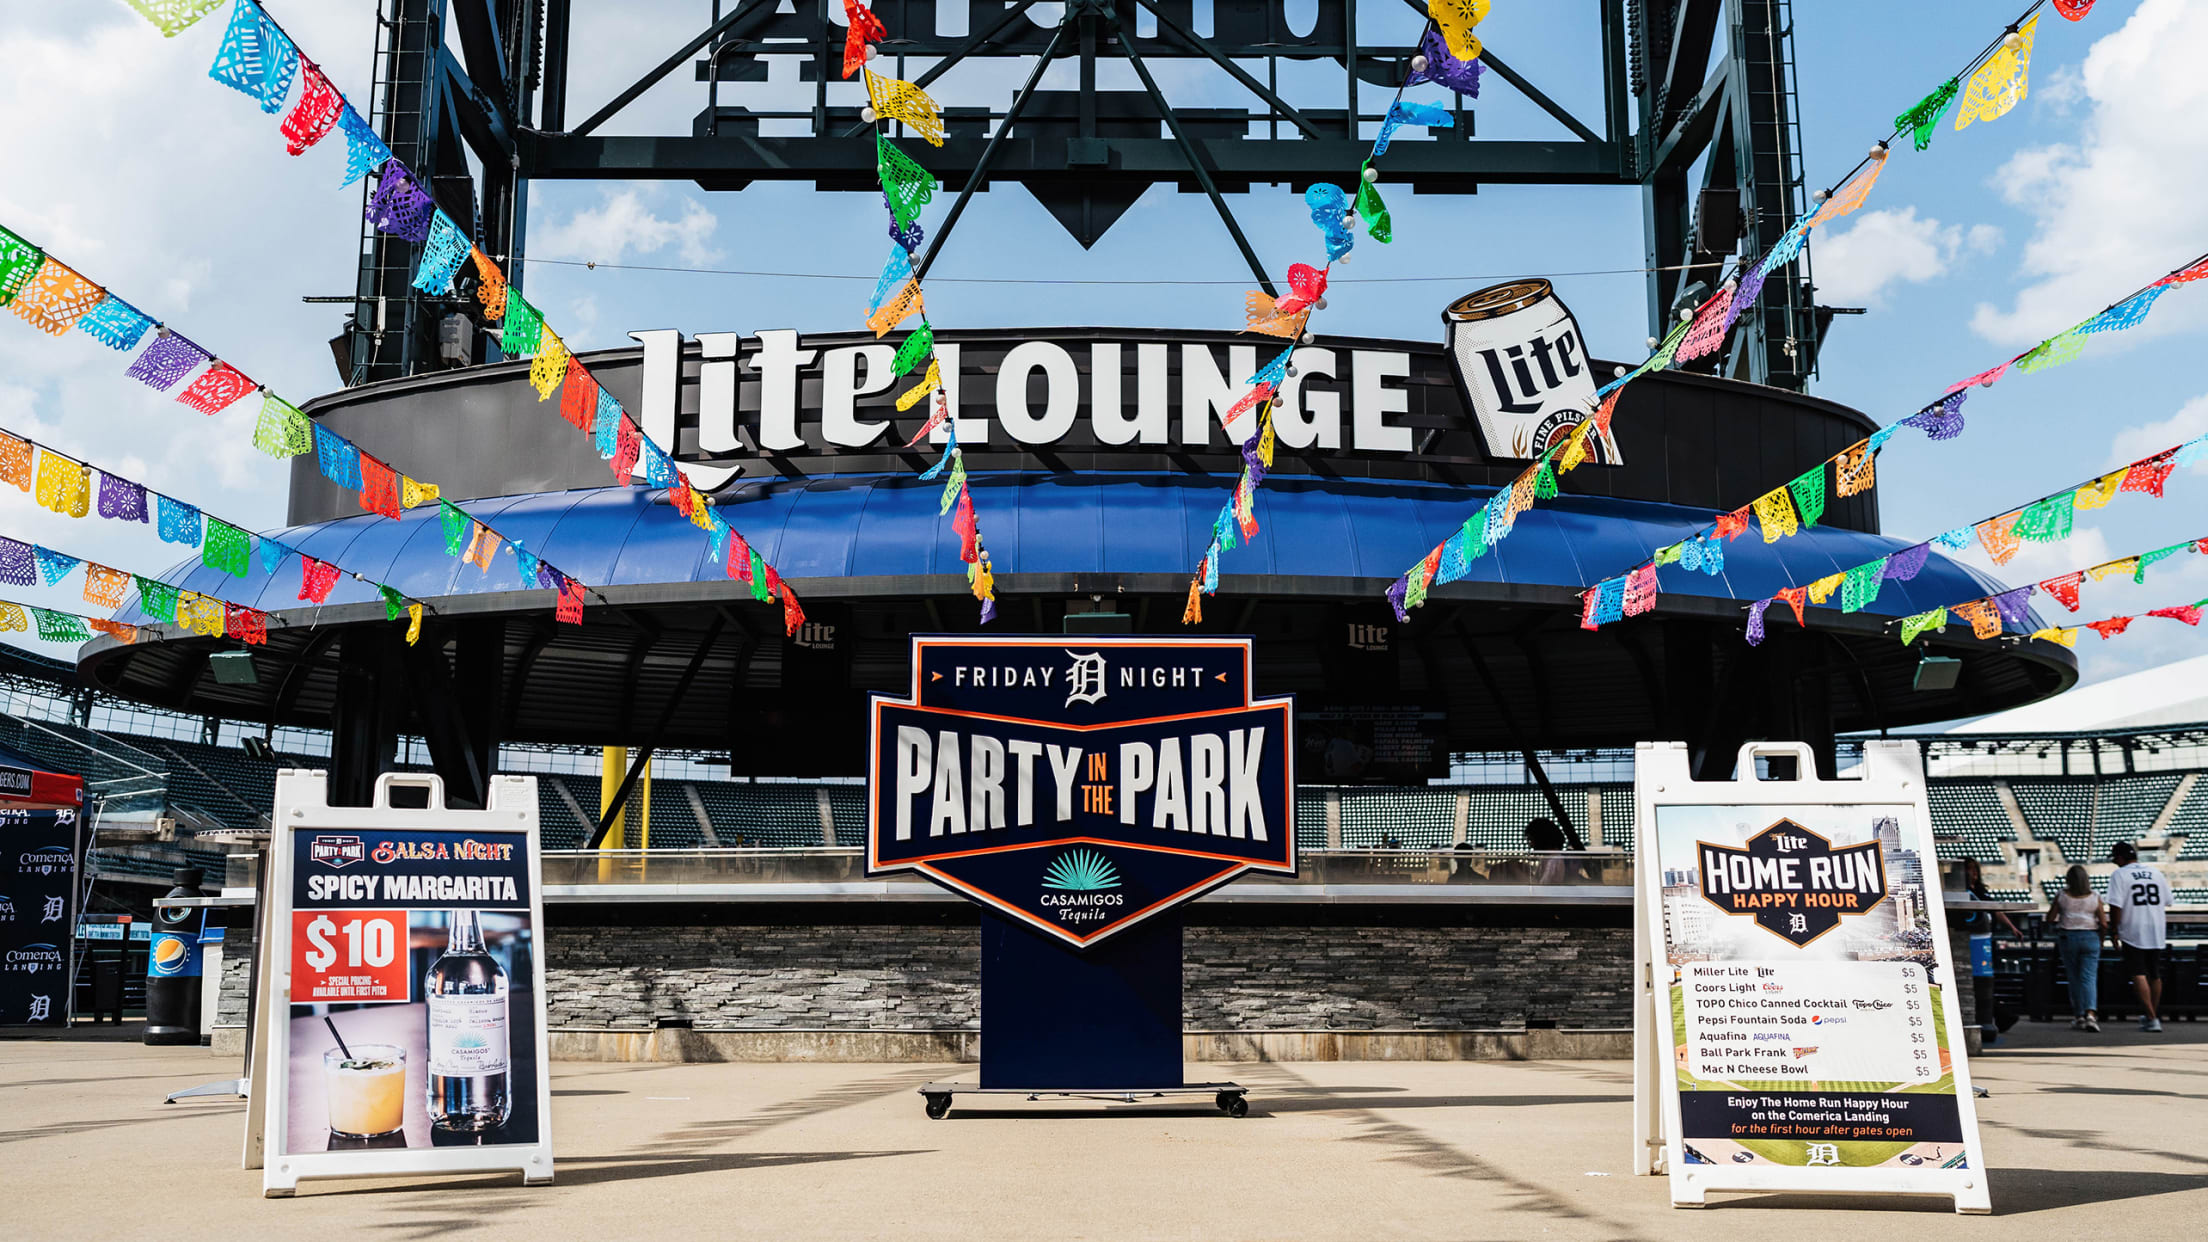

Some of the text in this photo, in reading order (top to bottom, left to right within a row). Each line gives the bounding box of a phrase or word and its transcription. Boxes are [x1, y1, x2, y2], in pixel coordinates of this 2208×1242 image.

[1475, 330, 1582, 414] Lite
[627, 328, 1413, 491] Lite LOUNGE
[1534, 419, 1554, 450] FINE
[794, 622, 836, 647] Lite
[1347, 623, 1389, 648] Lite
[955, 666, 1054, 687] FRIDAY
[1120, 667, 1204, 688] NIGHT
[896, 725, 1269, 841] PARTY IN THE PARK
[314, 845, 339, 858] PARTY
[342, 845, 362, 858] PARK
[371, 839, 514, 864] SALSA NIGHT
[1775, 835, 1808, 853] Lite
[1705, 849, 1880, 895] HOME RUN
[308, 875, 518, 901] SPICY MARGARITA
[2131, 883, 2161, 906] 28
[1040, 894, 1124, 906] CASAMIGOS
[1733, 892, 1859, 908] HAPPY HOUR
[1059, 908, 1106, 924] Tequila
[305, 914, 395, 973] $10
[1693, 967, 1916, 978] Miller Lite Lite $5
[1695, 983, 1726, 992] Coors
[1729, 983, 1756, 994] Light
[1904, 984, 1918, 994] $5
[1696, 999, 1725, 1008] TOPO
[1728, 999, 1758, 1008] Chico
[1760, 999, 1801, 1008] Canned
[1804, 999, 1848, 1008] Cocktail
[1906, 1000, 1920, 1010] $5
[1698, 1015, 1923, 1027] Pepsi Fountain Soda pepsi $5
[1699, 1031, 1925, 1043] Aquafina AQUAFINA $5
[1701, 1048, 1722, 1057] Ball
[1725, 1048, 1751, 1057] Park
[1754, 1048, 1786, 1057] Frank
[1913, 1049, 1927, 1060] $5
[1702, 1064, 1930, 1076] Mac N Cheese Bowl $5
[1727, 1096, 1910, 1110] Enjoy The Home Run Happy Hour
[1751, 1110, 1890, 1124] on the Comerica Landing
[1731, 1123, 1913, 1138] for the first hour after gates open
